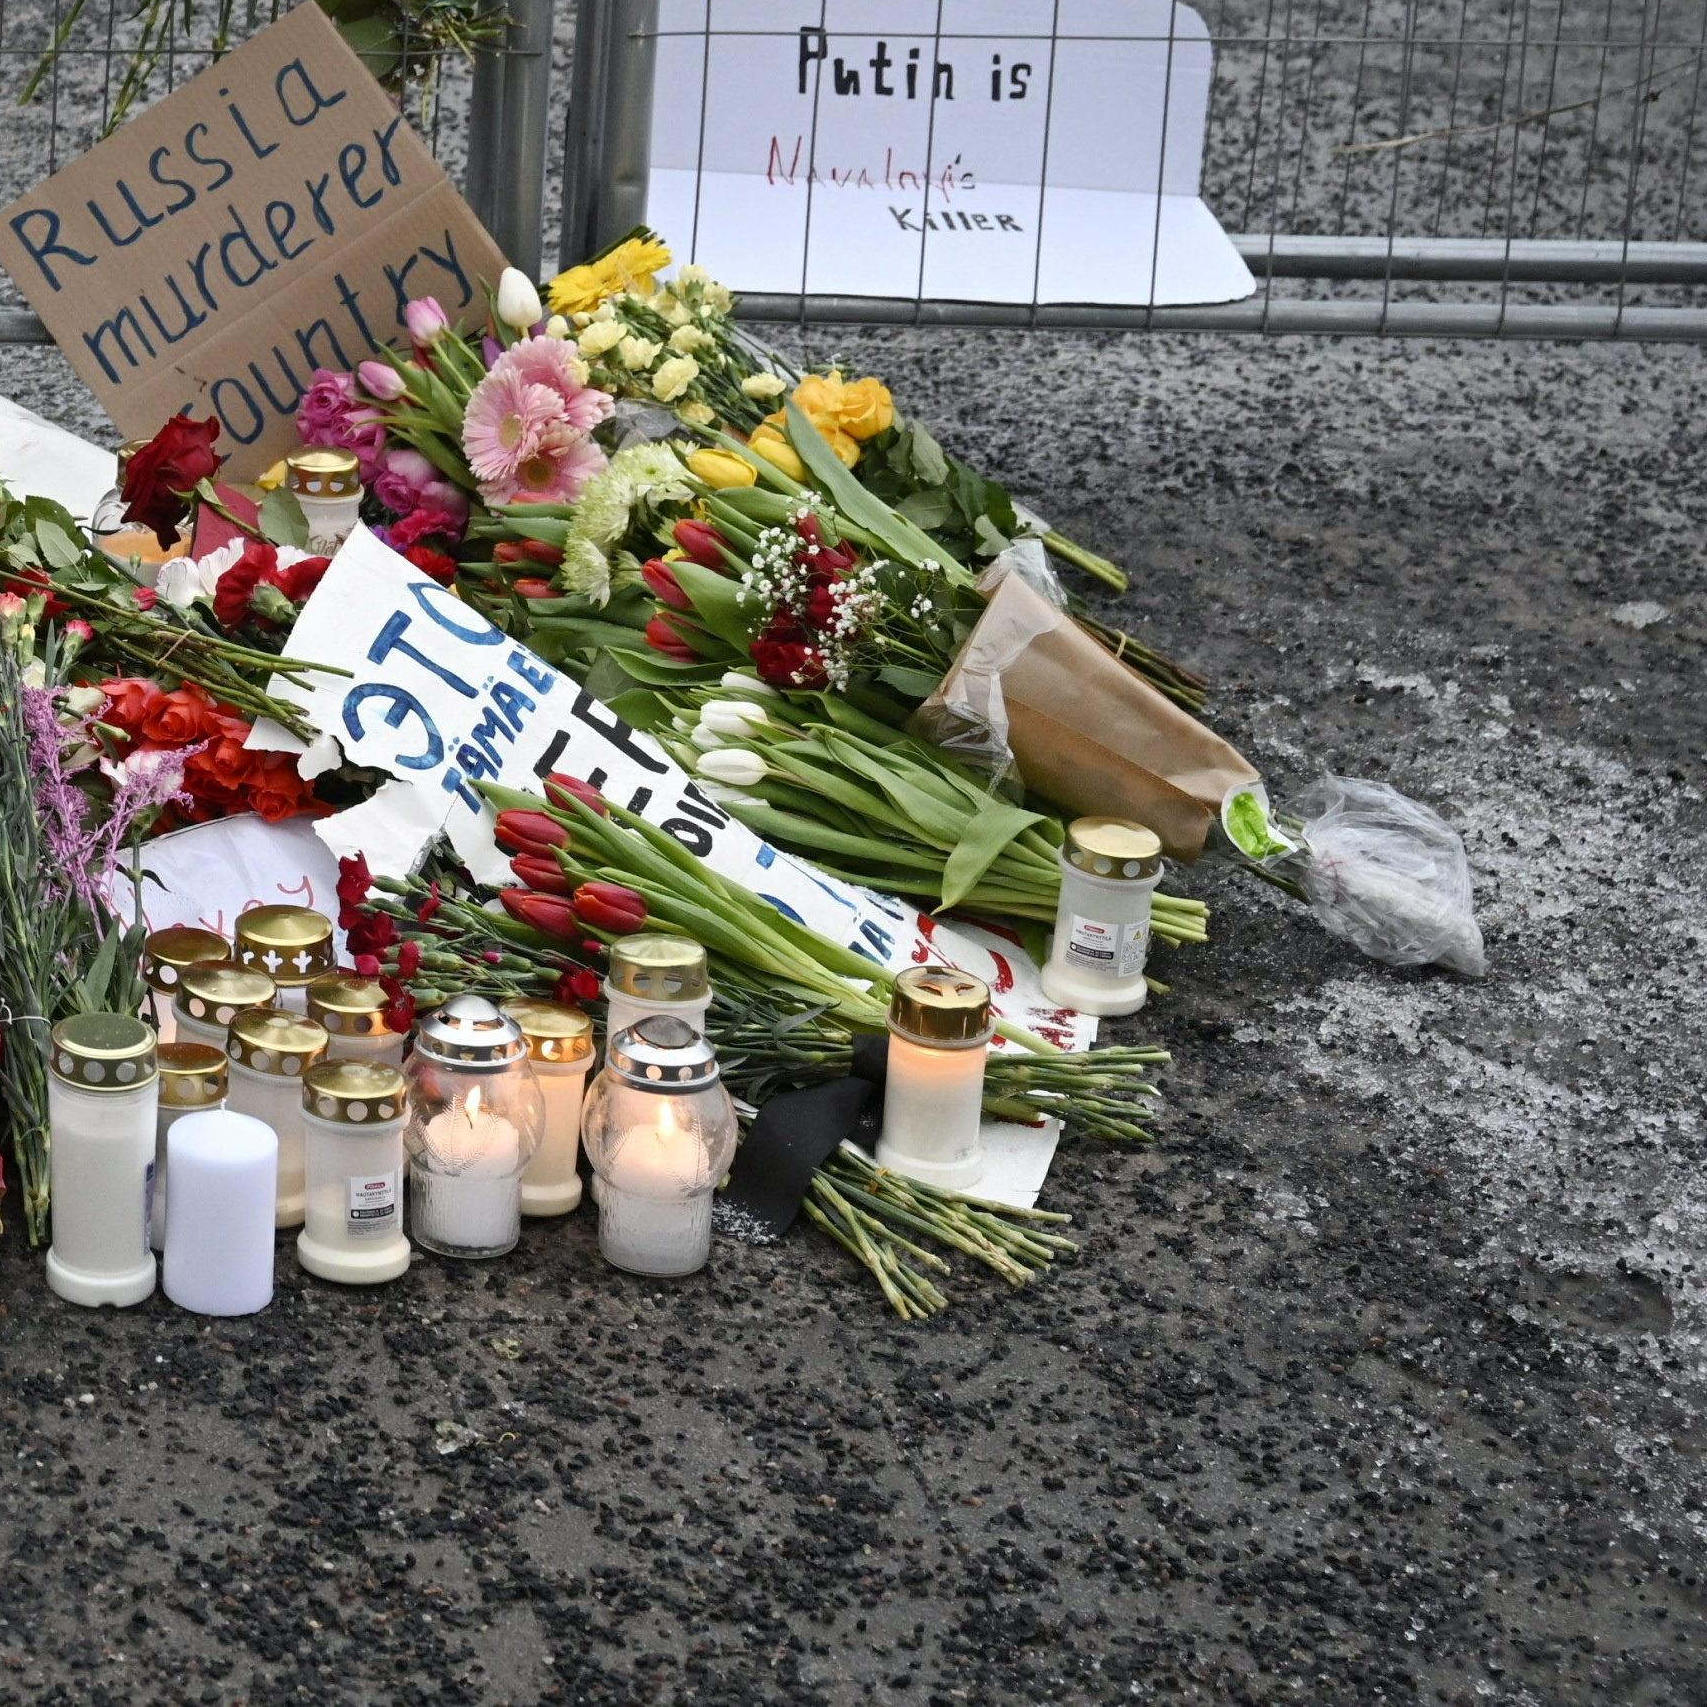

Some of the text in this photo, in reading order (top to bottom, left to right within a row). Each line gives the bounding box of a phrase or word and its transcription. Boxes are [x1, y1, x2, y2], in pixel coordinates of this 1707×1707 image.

[8, 57, 348, 293] Russia
[798, 25, 1033, 102] Putin is
[80, 114, 407, 385] murderer
[181, 228, 475, 467] ountry
[341, 582, 507, 770] ЭТО
